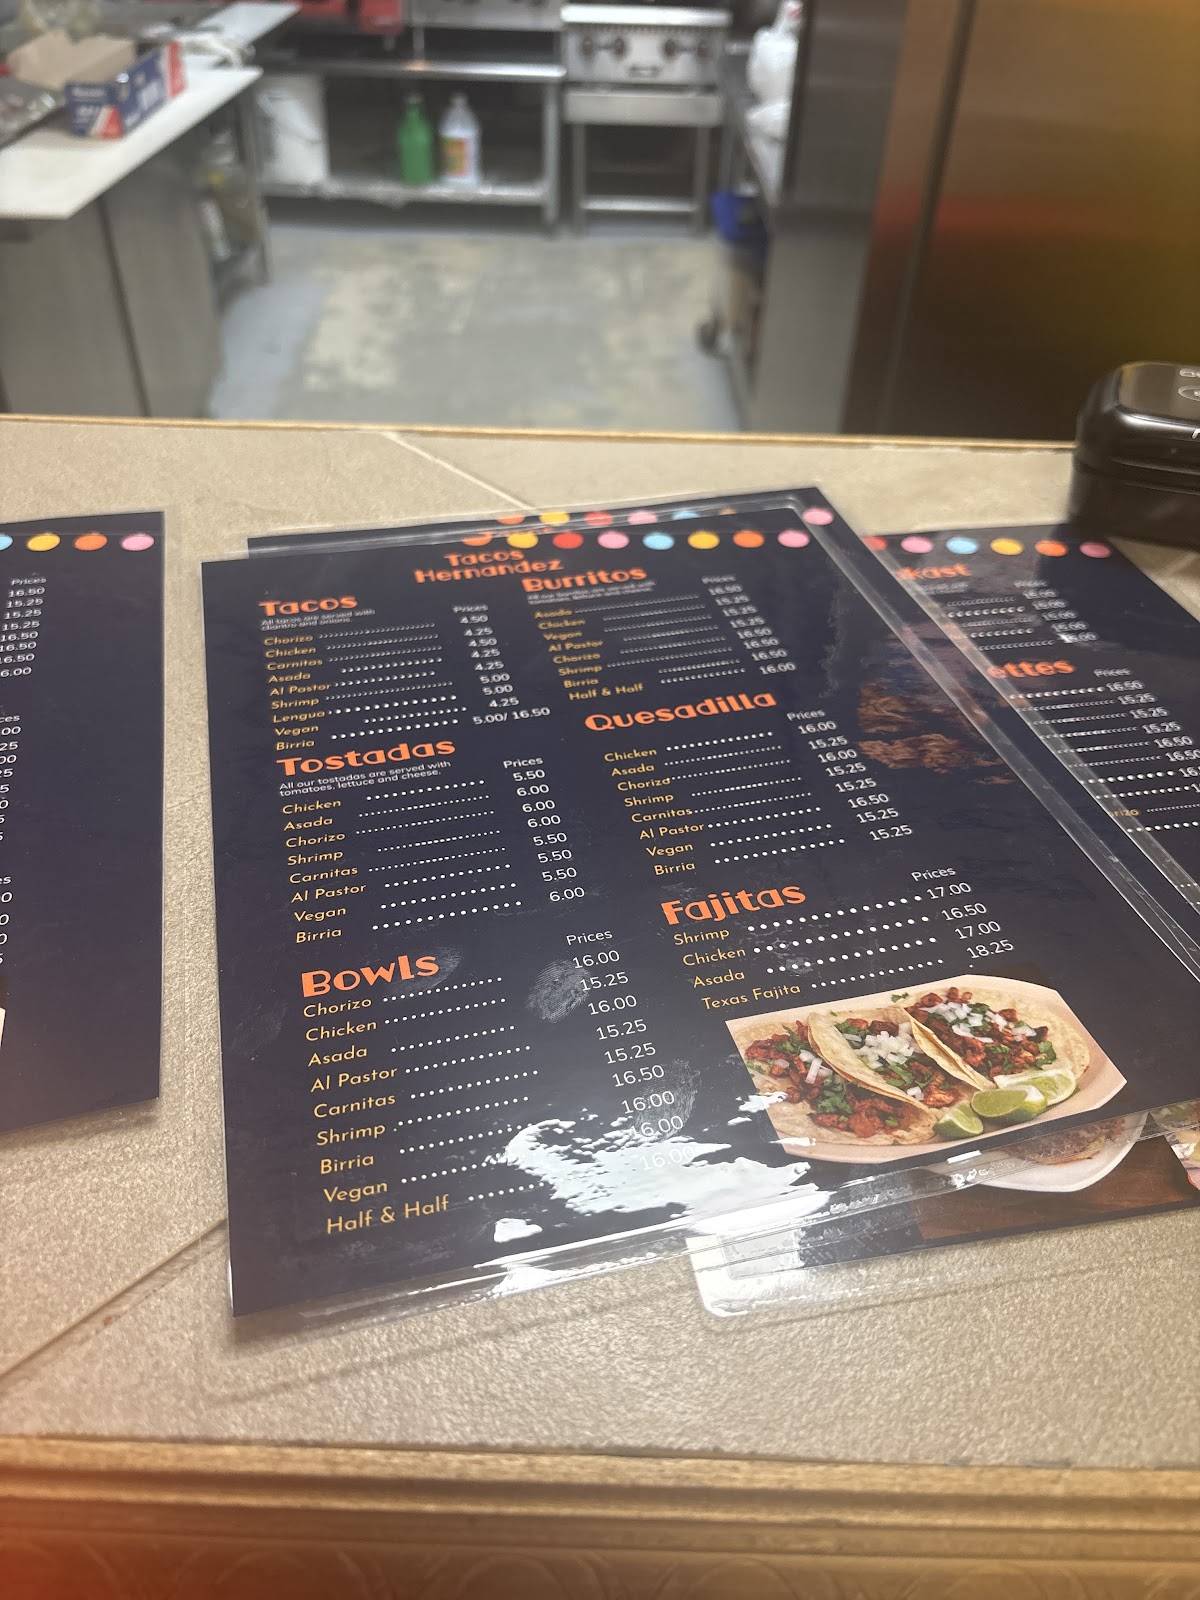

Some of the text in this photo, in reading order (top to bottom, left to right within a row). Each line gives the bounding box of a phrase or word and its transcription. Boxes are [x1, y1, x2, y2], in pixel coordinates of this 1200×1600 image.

[444, 550, 524, 567] Tacos
[414, 559, 564, 584] Hernandez
[521, 568, 647, 592] Burritos
[8, 587, 45, 598] 16.50
[259, 595, 358, 616] Tacos
[4, 609, 42, 619] 15.25
[459, 615, 489, 624] 4.50
[2, 621, 40, 631] 15.25
[464, 627, 493, 637] 4.25
[1, 631, 38, 642] 16.50
[264, 635, 314, 646] Chorizo
[468, 638, 498, 647] 4.50
[265, 646, 317, 658] Chicken
[471, 649, 501, 658] 4.25
[548, 640, 603, 652] Al Pastor
[266, 658, 323, 670] Carnitas
[475, 661, 504, 671] 4.25
[553, 653, 601, 664] Chorizo
[558, 665, 602, 676] Shrimp
[760, 662, 796, 675] 16.00
[268, 672, 311, 684] Asada
[480, 673, 511, 684] 5.00
[564, 678, 599, 689] Birria
[270, 683, 331, 696] Al Pastor
[482, 684, 514, 696] 5.00
[569, 682, 644, 701] Half & Half
[272, 697, 320, 709] Shrimp
[488, 697, 520, 708] 4.25
[1117, 693, 1156, 705] 15.25
[273, 711, 325, 723] Lengua
[512, 707, 551, 720] 16.50
[584, 692, 777, 731] Quesadilla
[787, 710, 825, 721] Prices
[1129, 706, 1169, 720] 15.25
[275, 725, 319, 737] Vegan
[798, 721, 837, 735] 16.00
[1142, 721, 1182, 735] 15.25
[276, 739, 315, 751] Birria
[808, 735, 848, 750] 15.25
[1153, 736, 1193, 749] 16.50
[276, 740, 456, 776] Tostadas
[503, 757, 544, 769] Prices
[604, 748, 657, 763] Chicken
[818, 749, 857, 763] 16.00
[279, 761, 452, 791] All our tostadas are served with
[513, 769, 546, 782] 5.50
[611, 763, 655, 777] Asada
[825, 762, 866, 777] 15.25
[338, 779, 375, 789] lettuce
[377, 774, 399, 784] and
[401, 769, 442, 781] cheese.
[617, 778, 670, 792] Chorizo
[835, 777, 877, 793] 15.25
[516, 784, 550, 797] 6.00
[283, 800, 341, 815] Chicken
[522, 800, 556, 813] 6.00
[624, 793, 674, 807] Shrimp
[847, 793, 889, 809] 16.50
[527, 815, 561, 828] 6.00
[631, 807, 692, 823] Carnitas
[856, 807, 899, 823] 15.25
[283, 816, 333, 831] Asada
[533, 832, 567, 846] 5.50
[639, 823, 704, 840] Al Pastor
[869, 824, 913, 841] 15.25
[285, 833, 346, 848] Chorizo
[537, 849, 572, 863] 5.50
[646, 843, 694, 857] Vegan
[287, 851, 344, 866] Shrimp
[289, 866, 358, 884] Carnitas
[541, 867, 577, 882] 5.50
[654, 861, 695, 876] Birria
[911, 867, 956, 882] Prices
[291, 884, 366, 903] Al Pastor
[549, 887, 585, 902] 6.00
[927, 882, 971, 899] 17.00
[661, 885, 806, 925] Fajitas
[942, 902, 987, 921] 16.50
[294, 907, 346, 922] Vegan
[296, 928, 342, 944] Birria
[566, 929, 613, 946] Prices
[674, 929, 730, 945] Shrimp
[955, 921, 1001, 939] 17.00
[682, 947, 746, 966] Chicken
[967, 940, 1014, 959] 18.25
[573, 950, 620, 969] 16.00
[301, 954, 440, 998] Bowls
[580, 971, 629, 991] 15.25
[693, 969, 745, 988] Asada
[701, 984, 800, 1010] Texas Fajita
[303, 997, 372, 1018] Chorizo
[587, 995, 637, 1016] 16.00
[305, 1020, 377, 1042] Chicken
[596, 1018, 647, 1040] 15.25
[308, 1045, 367, 1067] Asada
[604, 1042, 656, 1064] 15.25
[310, 1067, 397, 1093] Al Pastor
[612, 1064, 665, 1087] 16.50
[313, 1094, 396, 1118] Carnitas
[622, 1090, 675, 1114] 16.00
[316, 1123, 386, 1146] Shrimp
[320, 1153, 374, 1175] Birria
[323, 1182, 388, 1203] Vegan
[327, 1194, 449, 1235] Half & Half
